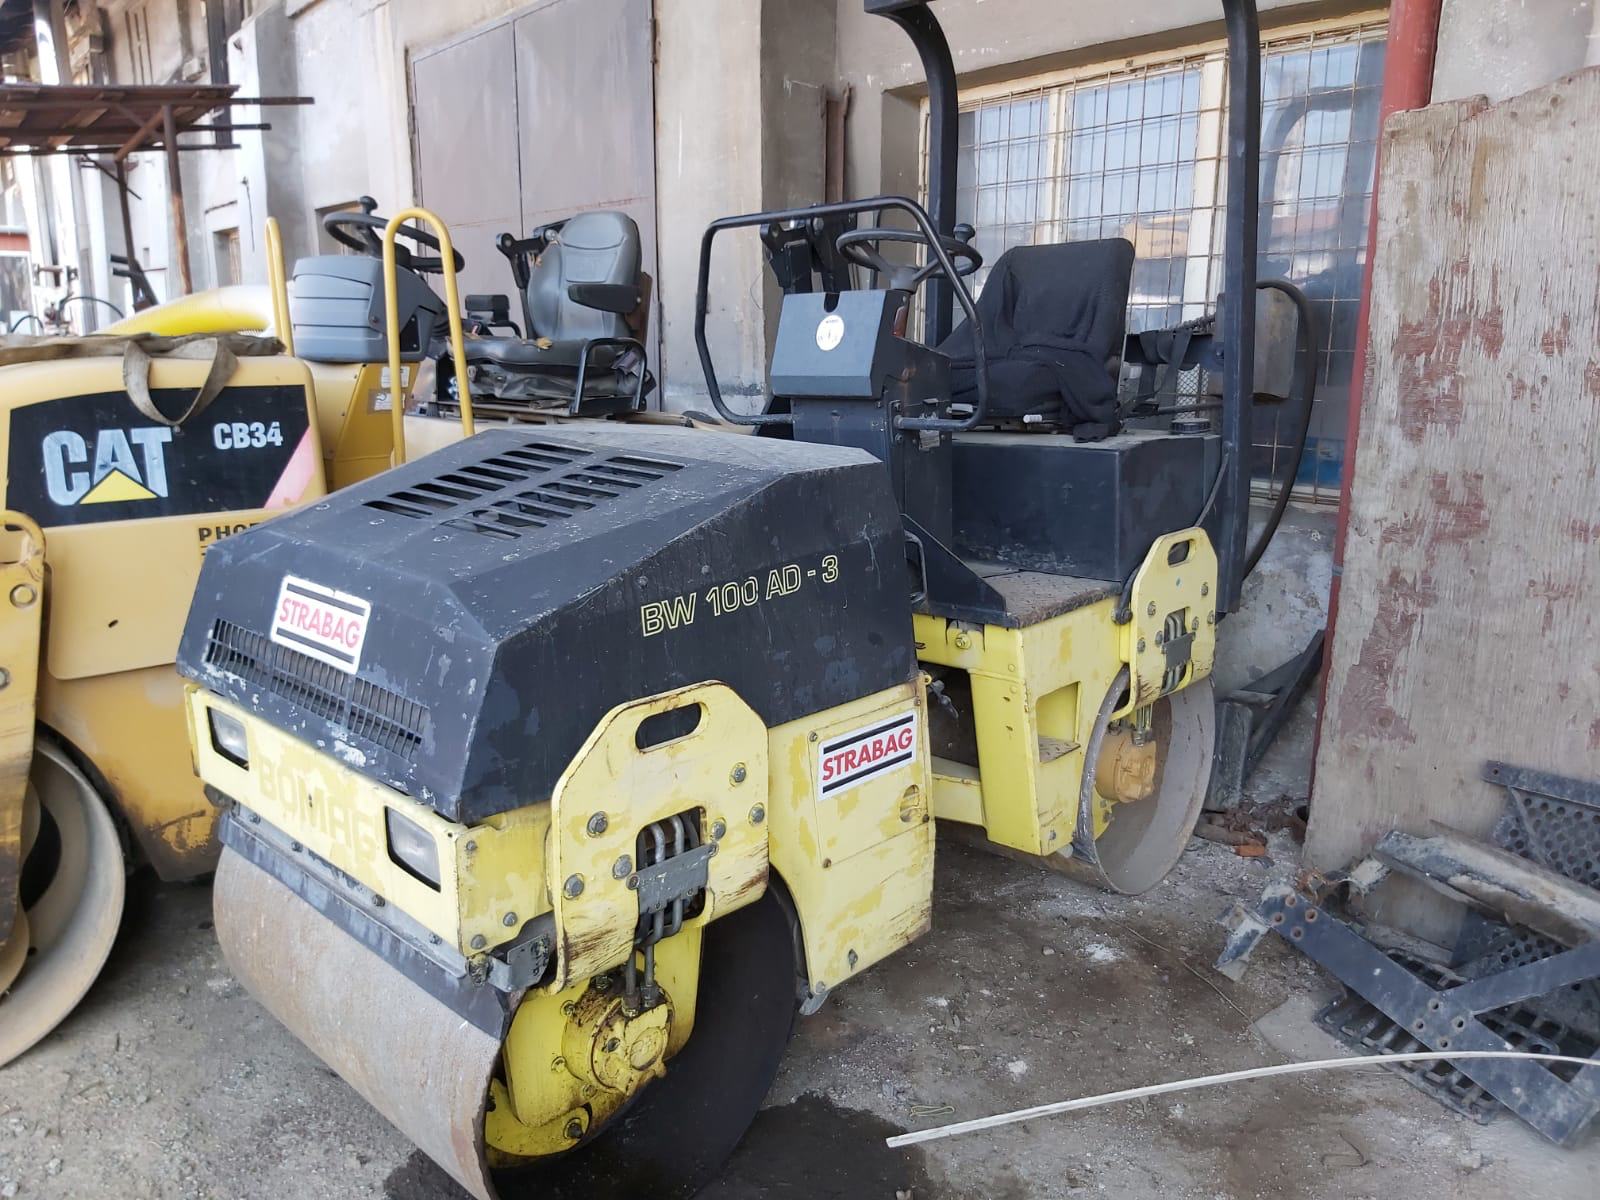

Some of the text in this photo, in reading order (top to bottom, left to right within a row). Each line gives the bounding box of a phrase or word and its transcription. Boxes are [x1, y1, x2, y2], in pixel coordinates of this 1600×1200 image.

[213, 421, 283, 450] CB34
[42, 427, 172, 506] CAT
[198, 522, 260, 541] PHO
[640, 592, 696, 637] BW
[706, 576, 759, 616] 100
[766, 564, 801, 600] AD
[822, 554, 838, 583] 3
[279, 598, 361, 648] STRABAG
[822, 727, 913, 781] STRABAG
[259, 755, 377, 863] BOMAG
